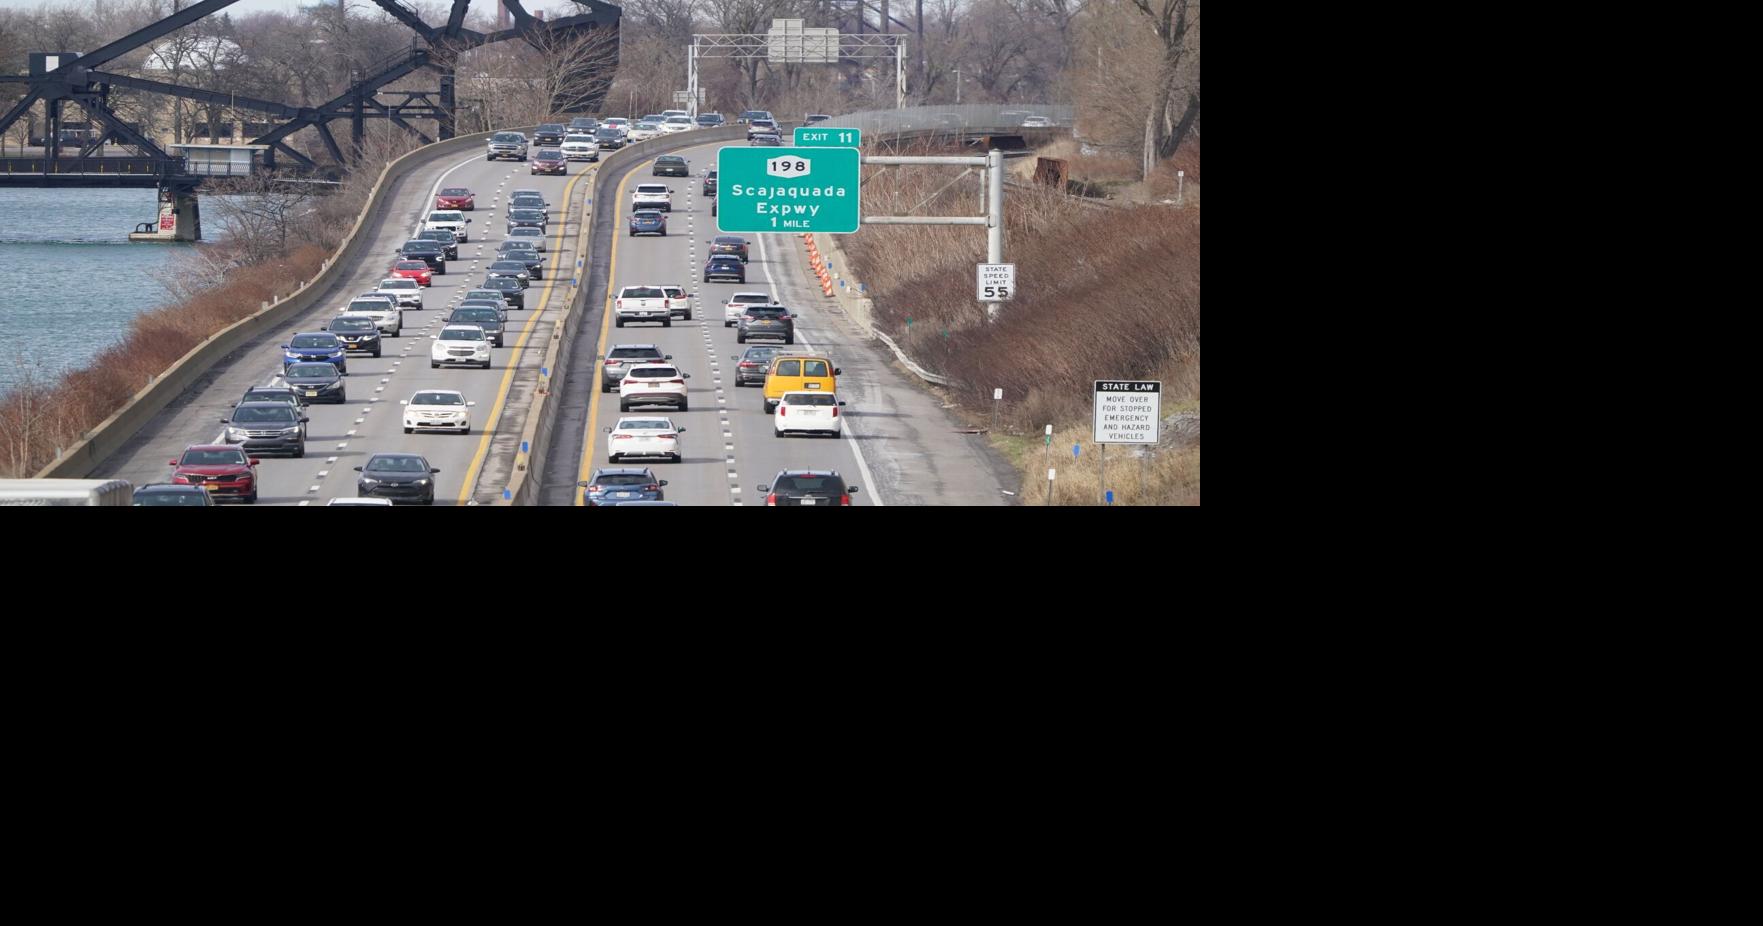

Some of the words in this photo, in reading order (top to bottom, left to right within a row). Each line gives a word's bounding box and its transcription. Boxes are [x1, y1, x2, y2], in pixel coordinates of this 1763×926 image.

[803, 133, 828, 141] EXIT
[838, 133, 852, 143] 11
[771, 162, 806, 172] 198
[732, 184, 846, 200] Scajaquada
[756, 202, 820, 216] Expwy
[770, 217, 777, 227] 1
[984, 287, 1008, 298] 55
